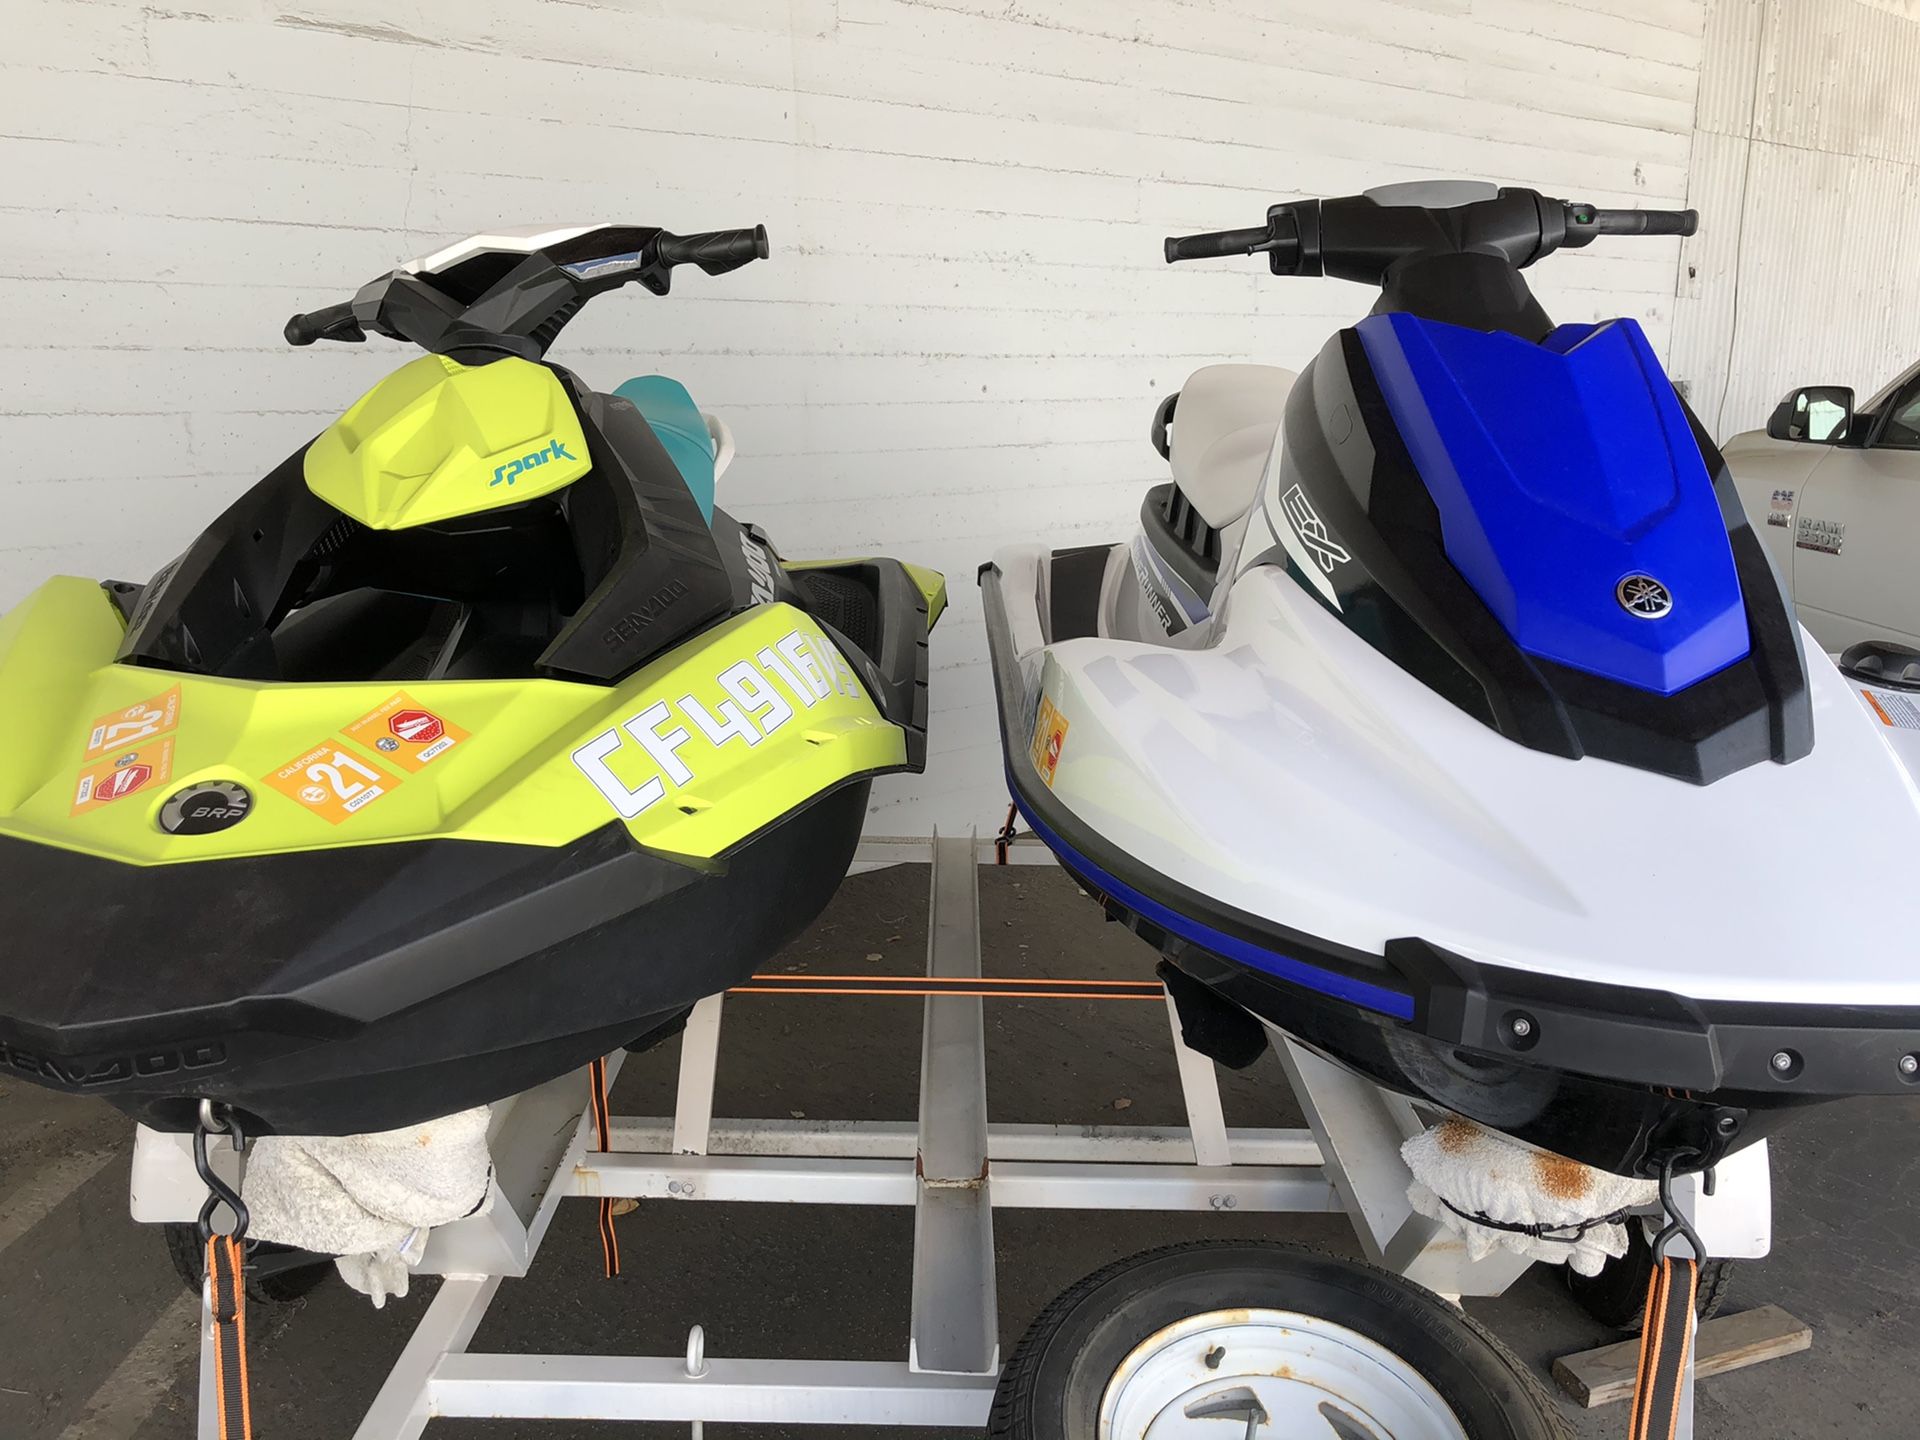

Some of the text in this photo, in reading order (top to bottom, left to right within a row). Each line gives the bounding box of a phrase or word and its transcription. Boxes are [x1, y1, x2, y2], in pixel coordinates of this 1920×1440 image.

[489, 439, 577, 486] spark
[1282, 483, 1351, 573] EX
[1797, 529, 1842, 548] 2500
[1799, 517, 1845, 536] RAM
[278, 747, 331, 778] CALIFORNIA
[306, 751, 381, 800] 21
[191, 807, 244, 819] BRP
